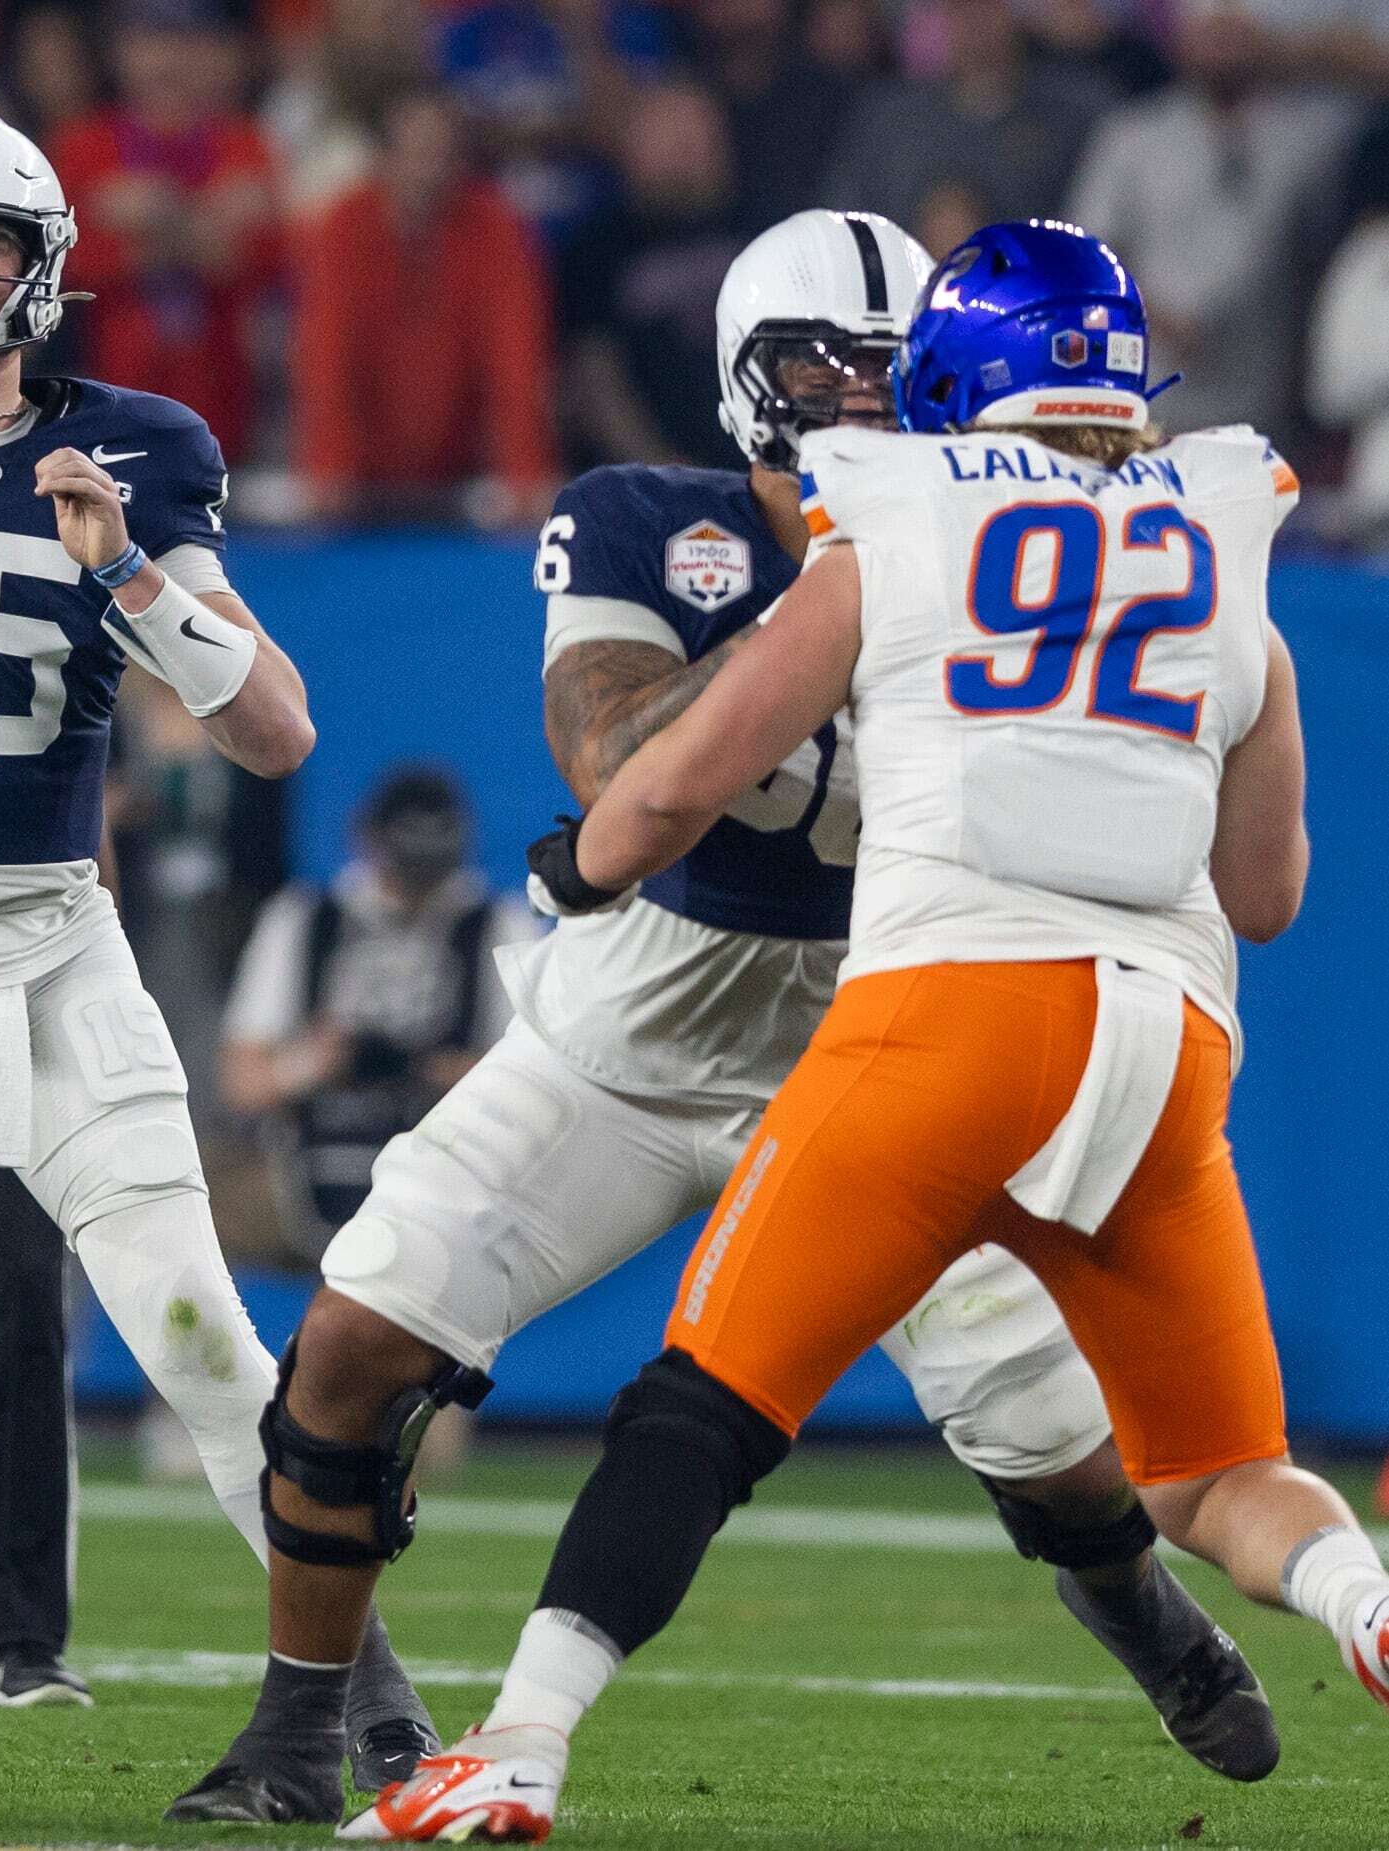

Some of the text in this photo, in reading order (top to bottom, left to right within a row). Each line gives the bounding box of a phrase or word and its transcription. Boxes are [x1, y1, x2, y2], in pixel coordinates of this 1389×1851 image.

[1033, 403, 1135, 419] BRONCOS
[943, 499, 1219, 743] 92
[682, 1135, 779, 1326] BRONCOS
